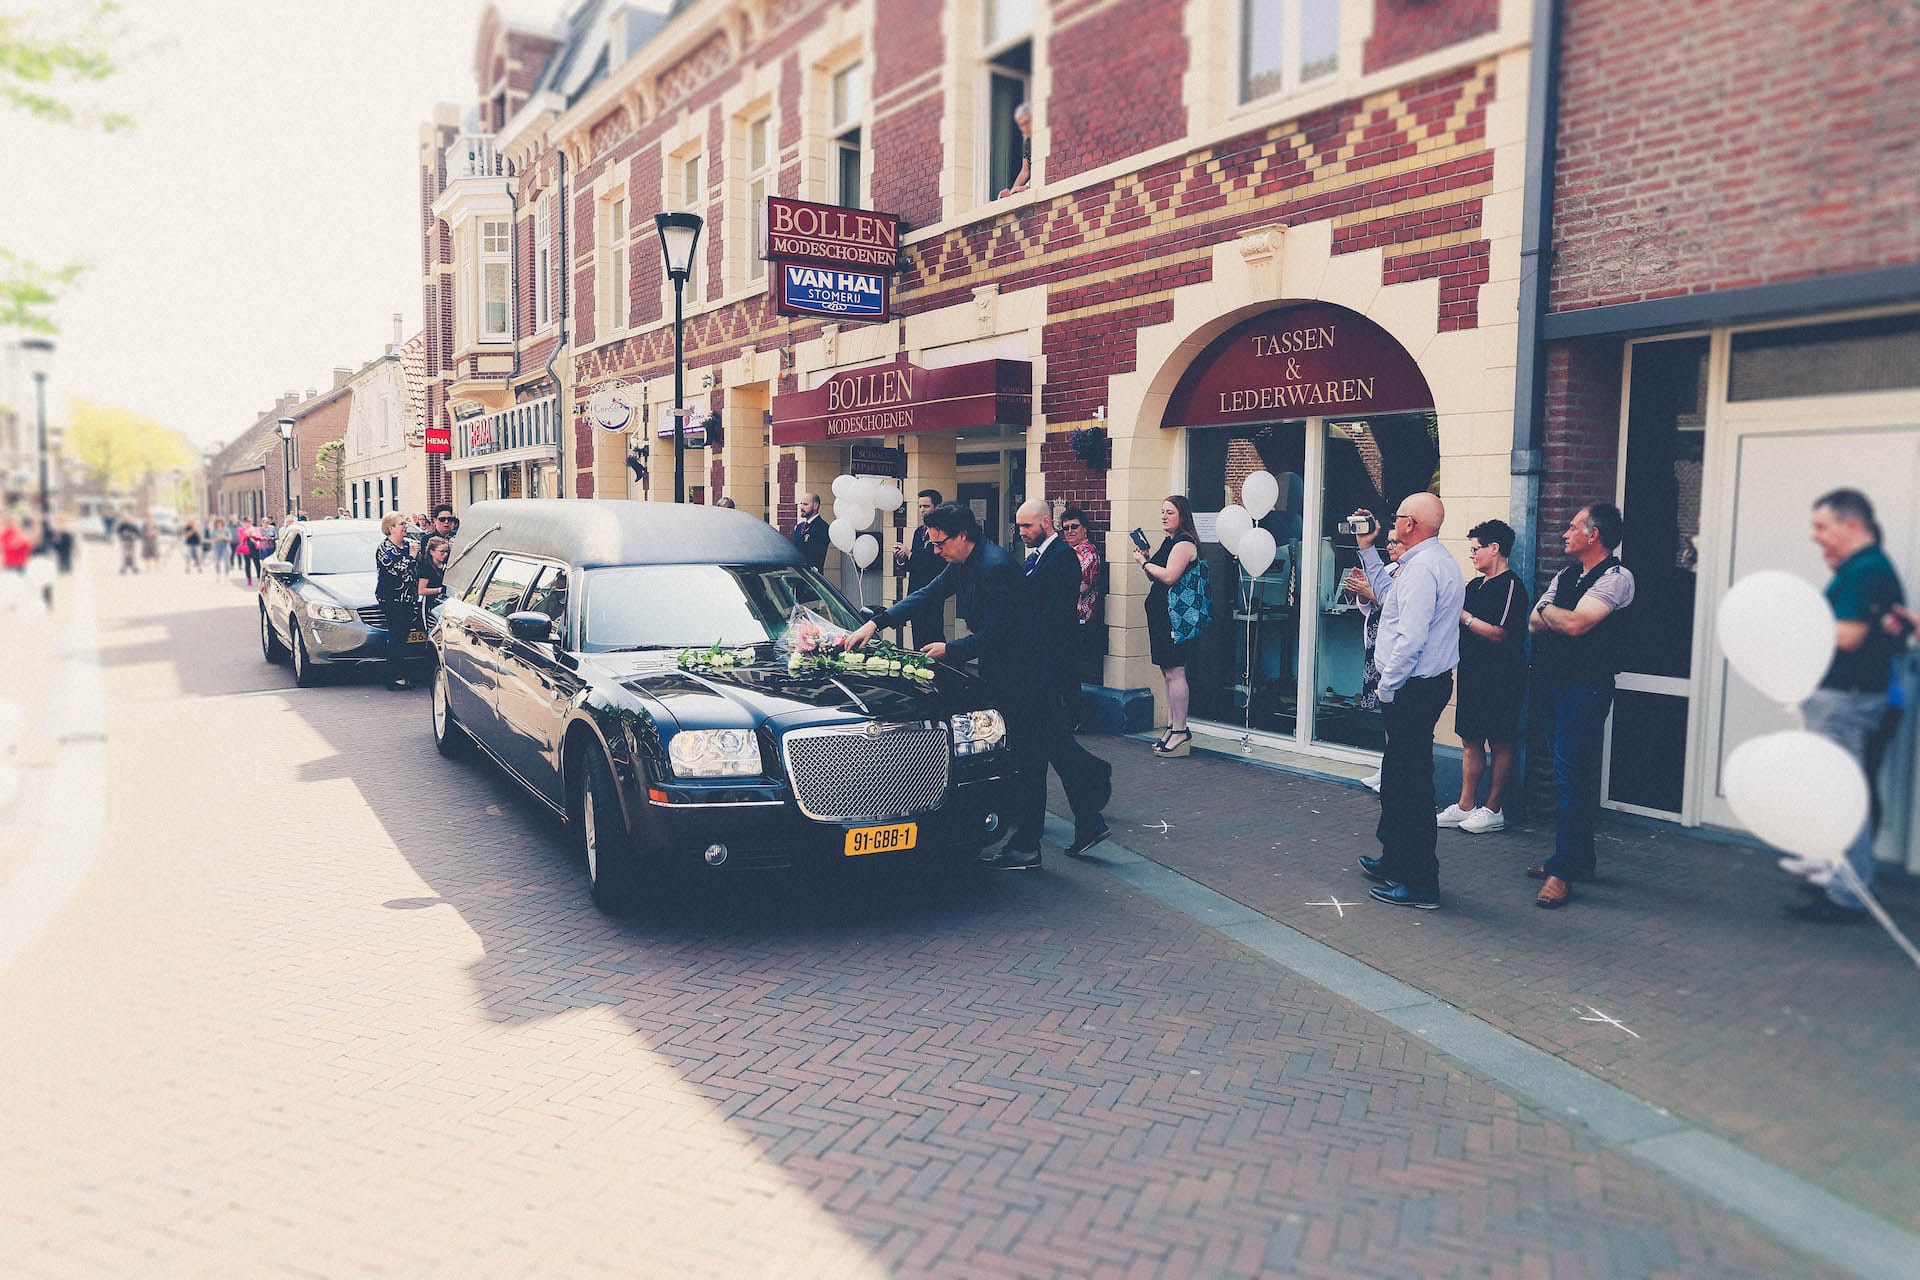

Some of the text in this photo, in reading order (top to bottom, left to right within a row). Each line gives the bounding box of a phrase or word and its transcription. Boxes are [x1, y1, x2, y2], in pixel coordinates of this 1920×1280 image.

[773, 204, 897, 247] BOLLEN
[773, 237, 897, 266] MODESCHOENEN
[788, 267, 881, 295] VAN HAL
[808, 288, 861, 304] STOMERIJ
[1251, 325, 1336, 358] TASSEN
[1285, 357, 1303, 381] &
[827, 367, 914, 411] BOLLEN
[1218, 377, 1375, 413] LEDERWAREN
[827, 409, 914, 435] MODESCHOENEN
[427, 437, 449, 445] HEMA
[854, 827, 910, 851] 91-GBB-1
